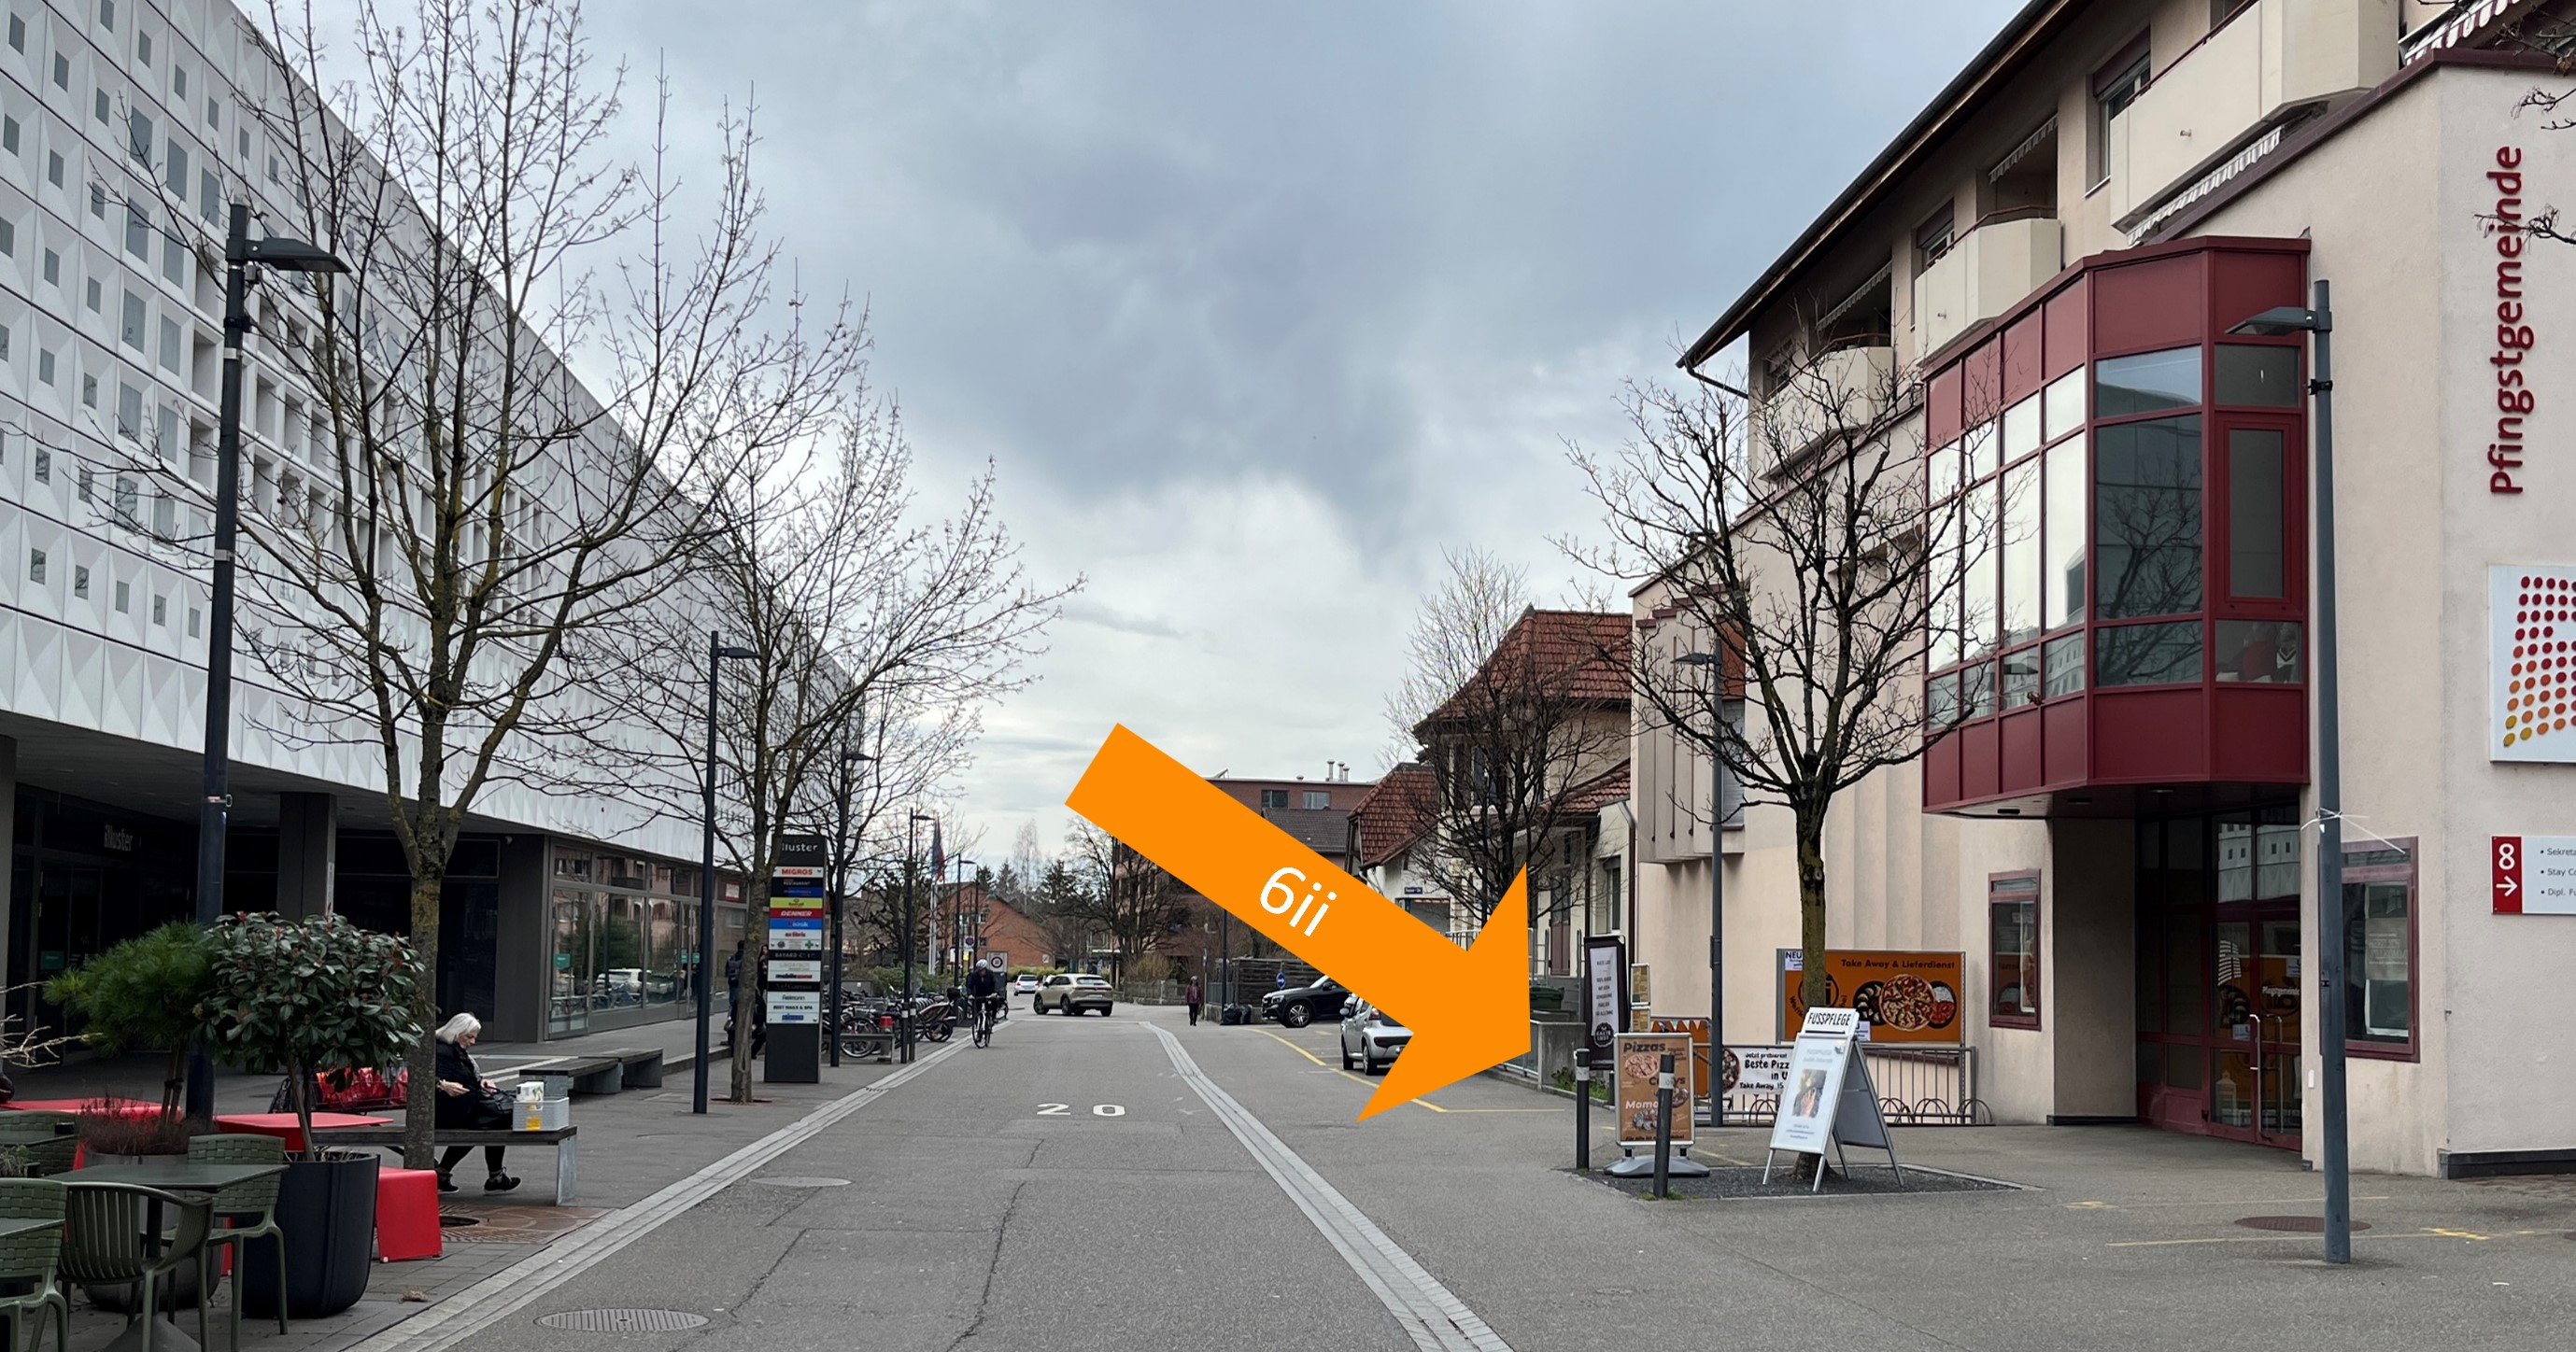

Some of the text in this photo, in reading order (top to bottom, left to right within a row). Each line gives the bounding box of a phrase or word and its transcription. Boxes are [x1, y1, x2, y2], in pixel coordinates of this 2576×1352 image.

[2486, 146, 2535, 495] Pfingstgemeinde
[2498, 842, 2515, 870] 8
[2547, 867, 2566, 877] Stay
[2547, 888, 2566, 898] Dipl.
[1785, 951, 1803, 960] NEU
[1840, 959, 1955, 970] Take Away & Lieferdienst
[1806, 1012, 1851, 1026] FUSSPFLEGE
[1622, 1040, 1666, 1053] Pizzas
[1744, 1059, 1769, 1069] Beste
[1771, 1059, 1790, 1069] Pizz
[1771, 1071, 1779, 1080] in
[1625, 1100, 1659, 1109] Momo
